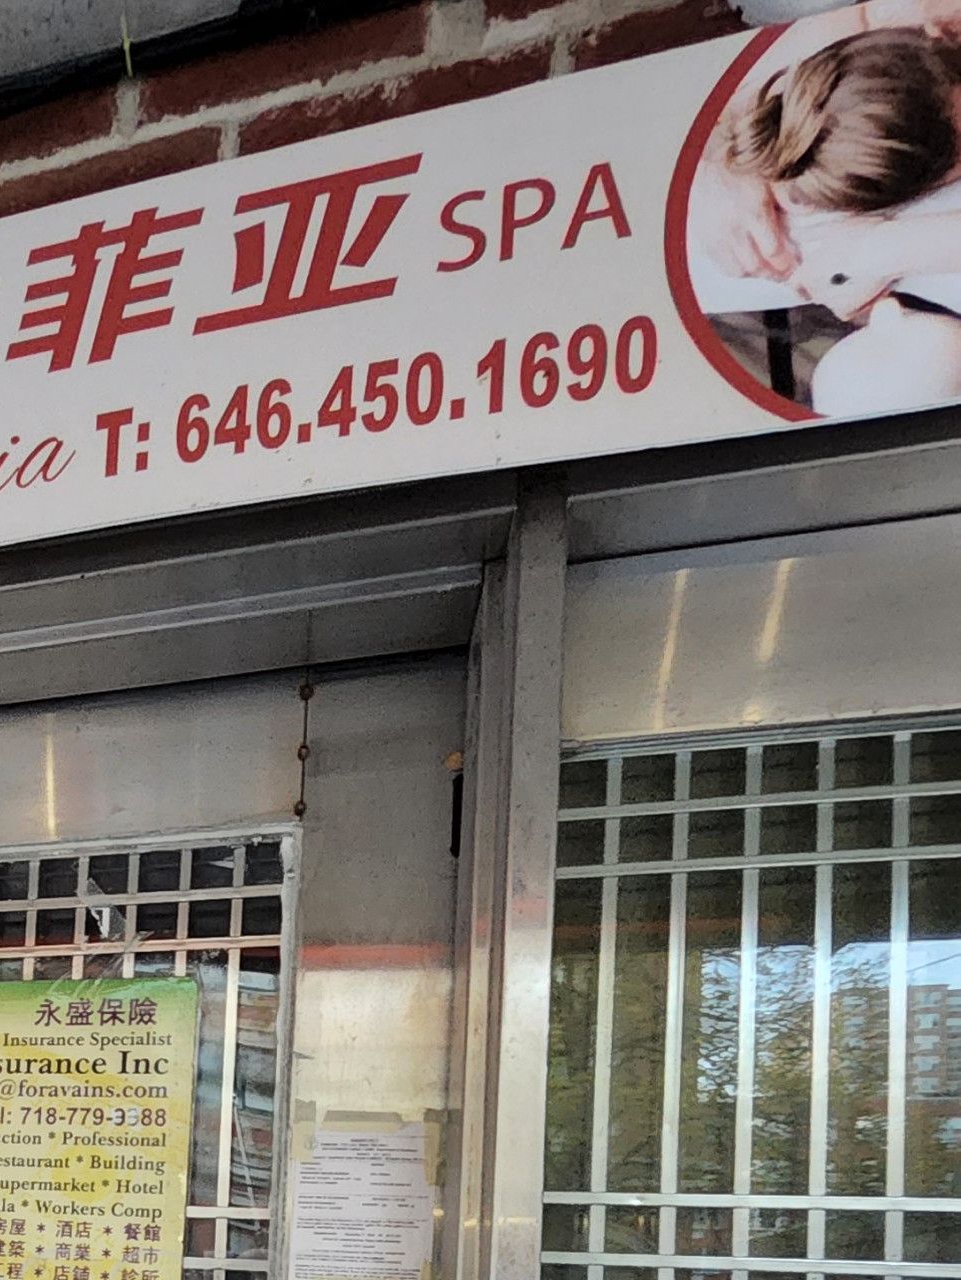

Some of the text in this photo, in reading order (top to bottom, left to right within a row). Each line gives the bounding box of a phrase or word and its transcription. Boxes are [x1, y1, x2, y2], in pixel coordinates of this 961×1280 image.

[438, 163, 631, 273] SPA
[96, 315, 658, 477] T: 646.450.1690
[34, 996, 158, 1027] 永盛保險
[3, 1033, 85, 1047] Insurance
[90, 1032, 172, 1050] Specialist
[117, 1050, 169, 1075] Inc
[62, 1131, 167, 1147] Professional
[89, 1155, 167, 1176] Building
[115, 1179, 164, 1195] Hotel
[35, 1199, 106, 1217] Workers
[111, 1202, 163, 1223] Comp
[55, 1219, 93, 1239] 酒店
[123, 1223, 162, 1242] 餐館
[55, 1242, 91, 1262] 商業
[121, 1245, 161, 1266] 超市
